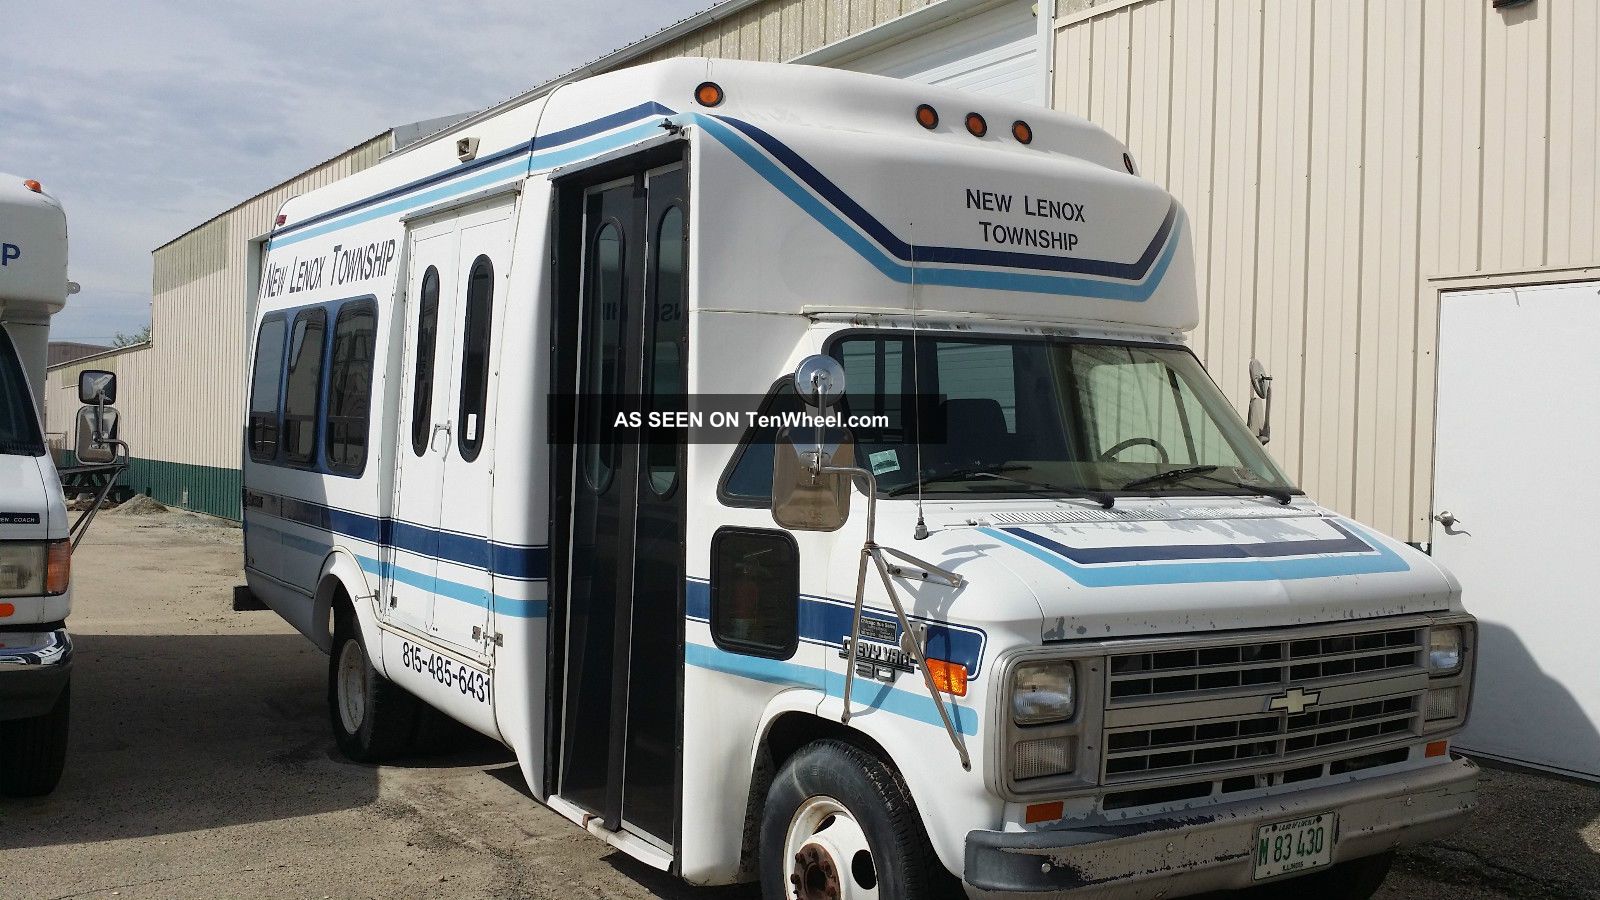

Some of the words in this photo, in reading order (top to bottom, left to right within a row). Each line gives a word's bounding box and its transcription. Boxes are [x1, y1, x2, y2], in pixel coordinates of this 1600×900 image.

[966, 188, 1013, 213] NEW
[1024, 195, 1086, 223] LENOX
[978, 221, 1079, 251] TOWNSHIP
[263, 261, 289, 298] NEW
[289, 255, 326, 294] LENOX
[330, 239, 396, 286] TOWNSHIP
[843, 639, 882, 660] CEVY
[402, 641, 491, 706] 815-485-6431
[1273, 833, 1292, 862] 83
[1296, 827, 1324, 857] 430
